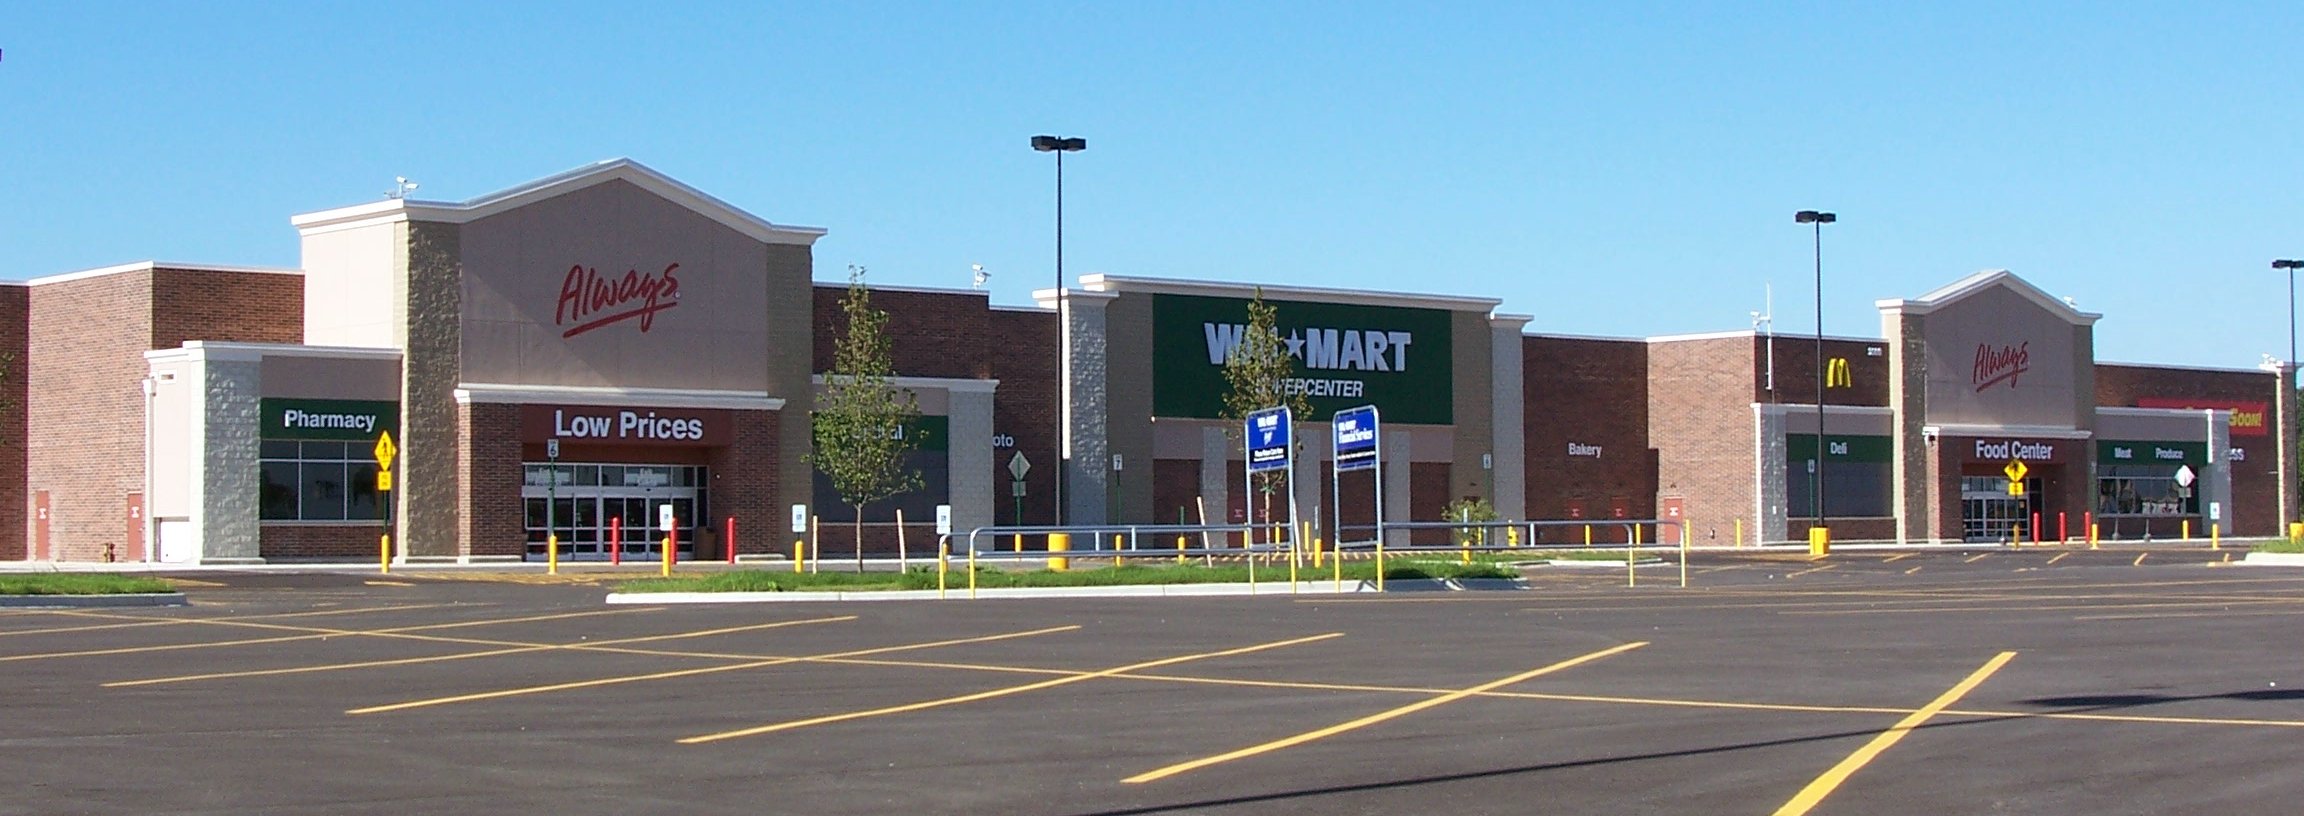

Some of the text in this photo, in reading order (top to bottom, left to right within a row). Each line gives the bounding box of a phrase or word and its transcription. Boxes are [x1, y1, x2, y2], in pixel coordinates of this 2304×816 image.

[557, 263, 680, 334] Always
[1973, 341, 2029, 390] Always
[284, 409, 376, 433] Pharmacy
[555, 410, 704, 440] Low Prices
[1568, 442, 1602, 459] Bakery
[1830, 442, 1847, 454] Deli
[1975, 440, 2053, 459] Food Center
